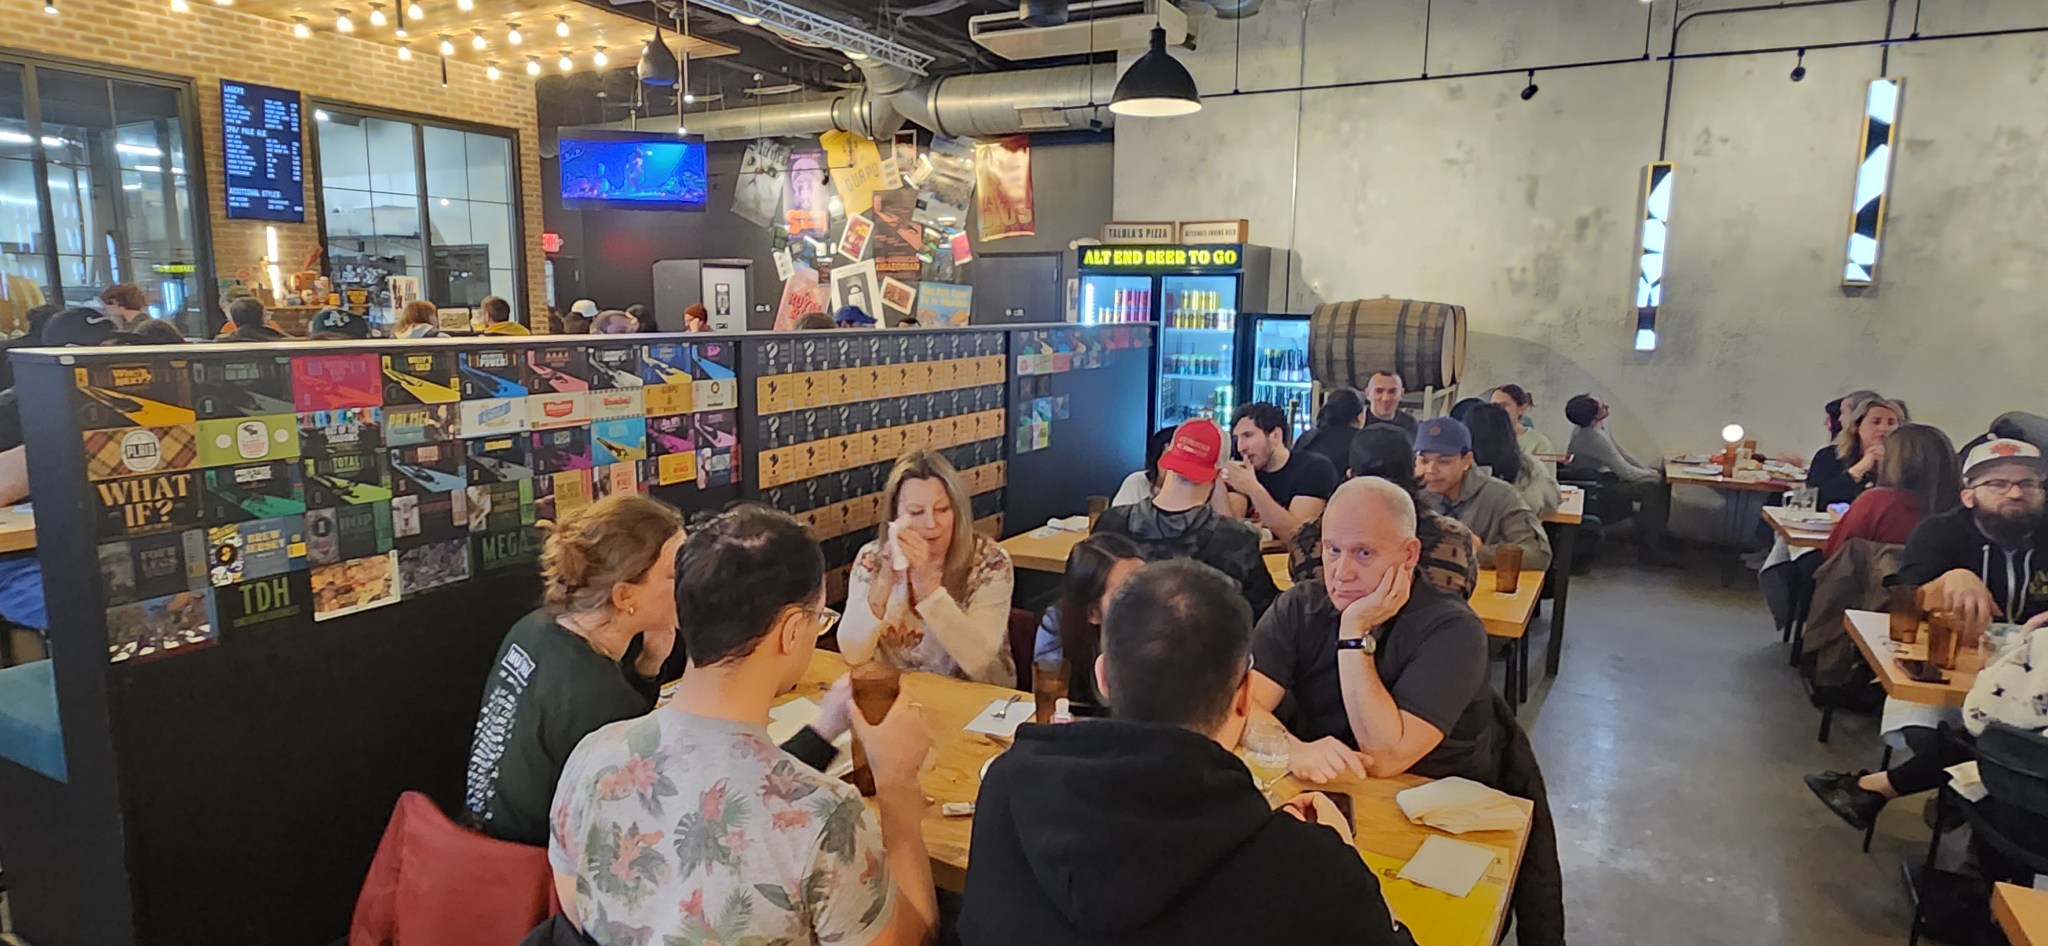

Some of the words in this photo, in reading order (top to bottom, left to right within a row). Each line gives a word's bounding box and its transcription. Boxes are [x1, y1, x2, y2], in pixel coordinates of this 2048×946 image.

[845, 162, 879, 192] GUAPO
[1108, 228, 1143, 239] TALULA'S
[1146, 228, 1168, 238] PIZZA
[1083, 249, 1112, 266] ALT
[1113, 249, 1144, 266] END
[1145, 249, 1187, 265] BEER
[1188, 249, 1210, 265] TO
[1212, 249, 1238, 265] GO
[332, 454, 361, 469] TOTAL
[97, 473, 191, 507] WHAT
[124, 500, 173, 528] IF?
[482, 529, 529, 563] MEGA
[238, 576, 291, 615] TDH
